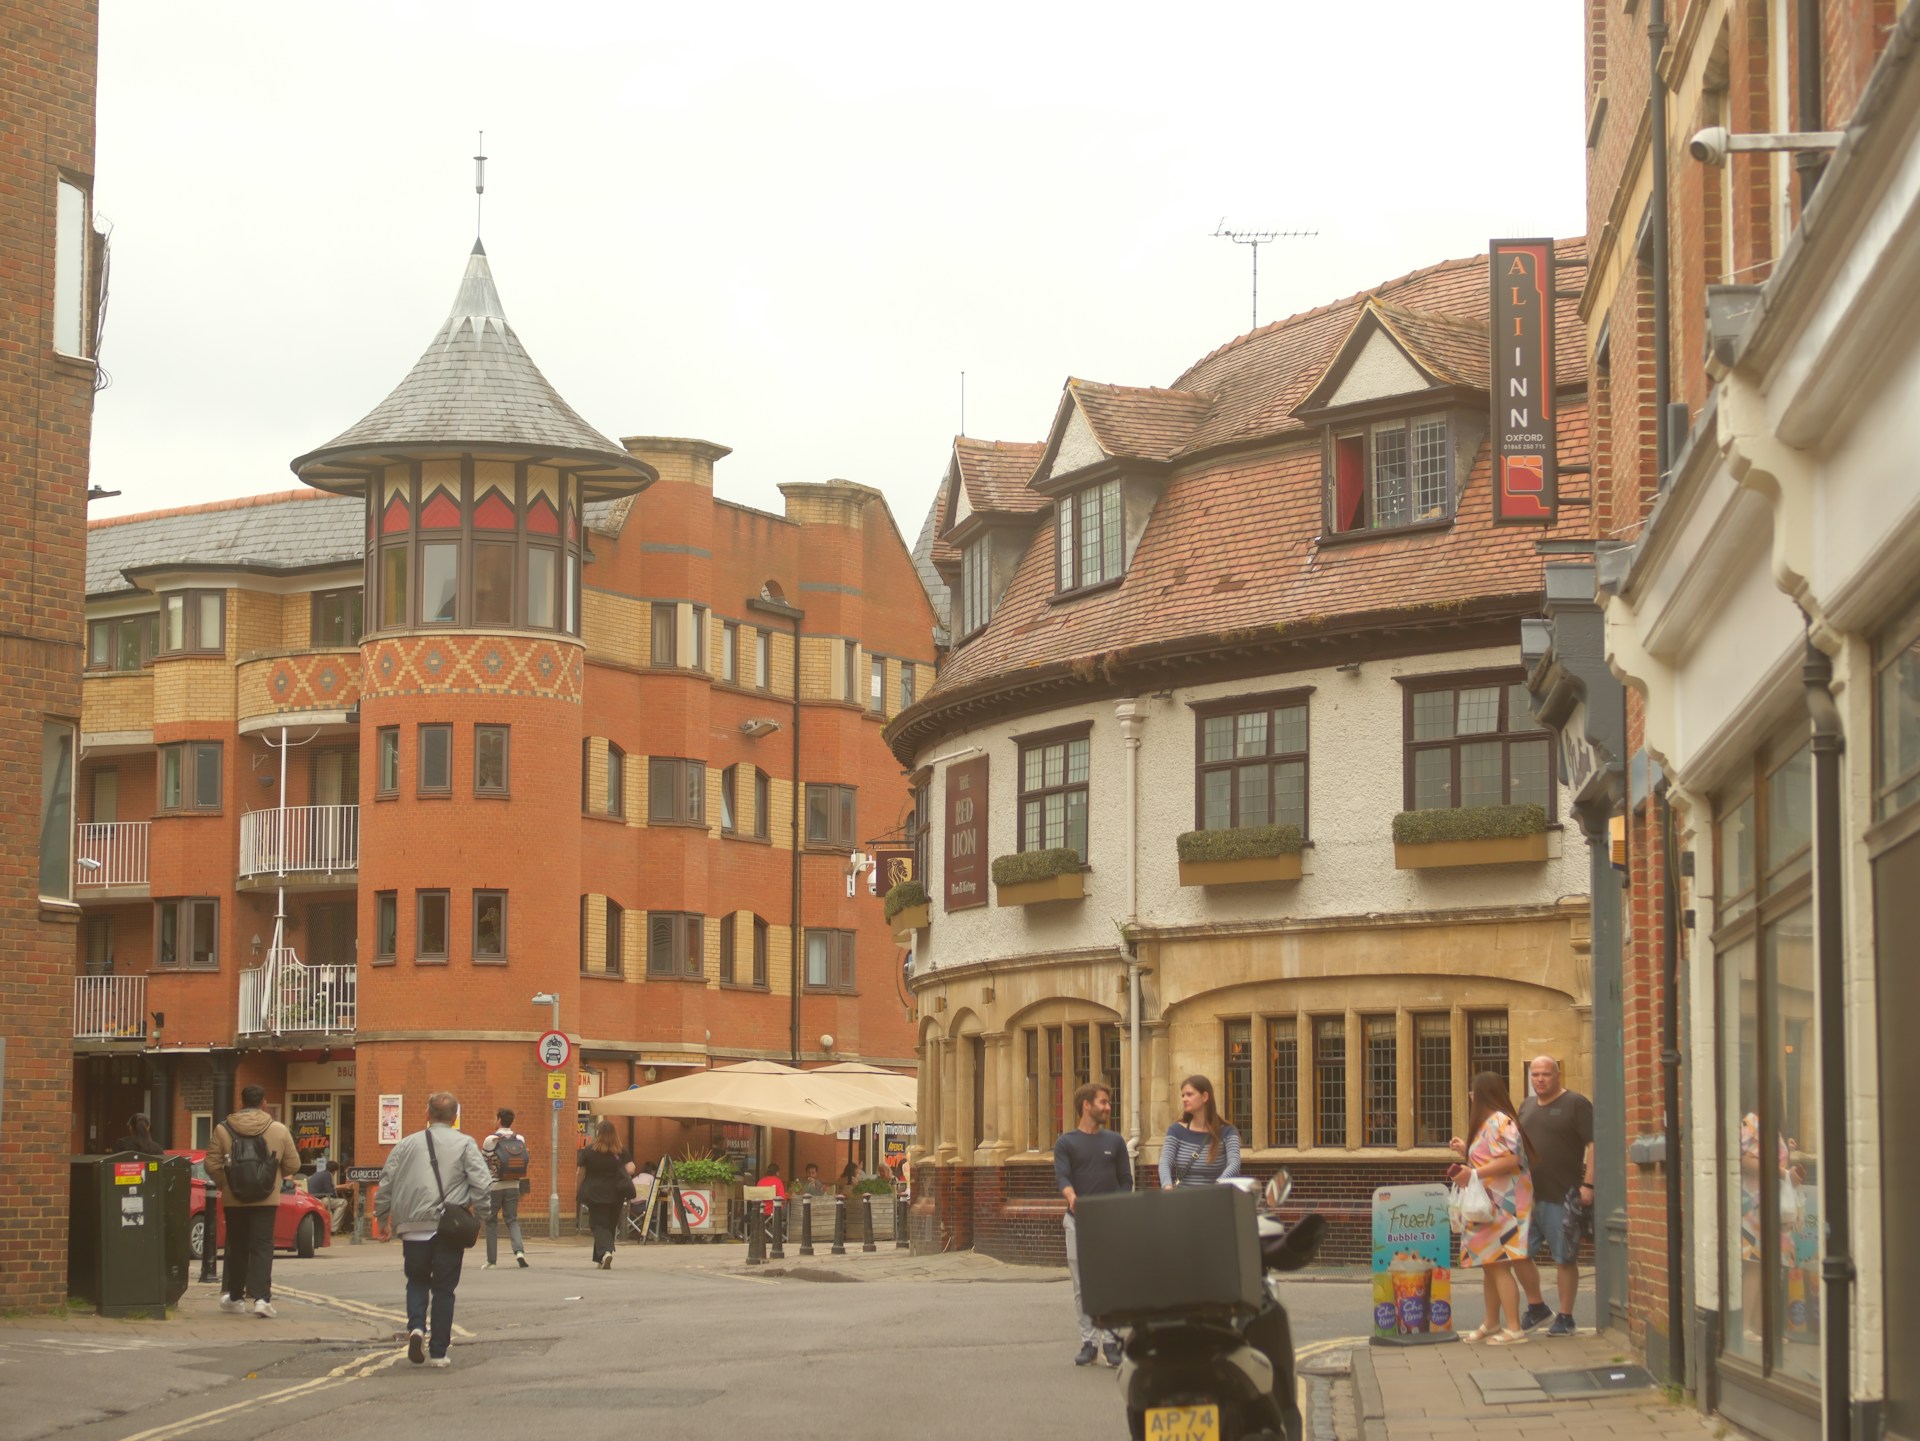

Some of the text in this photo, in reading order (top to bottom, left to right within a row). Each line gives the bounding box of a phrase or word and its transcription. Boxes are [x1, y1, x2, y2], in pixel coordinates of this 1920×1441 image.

[1508, 256, 1528, 428] ALI INN
[1505, 434, 1543, 442] OXFORD
[959, 774, 970, 791] THE
[955, 797, 974, 826] RED
[952, 828, 976, 859] LION
[296, 1110, 326, 1120] APERITIVO
[1388, 1204, 1435, 1233] Fresh
[1388, 1232, 1436, 1242] Bubble Tea
[1151, 1408, 1214, 1433] AP74
